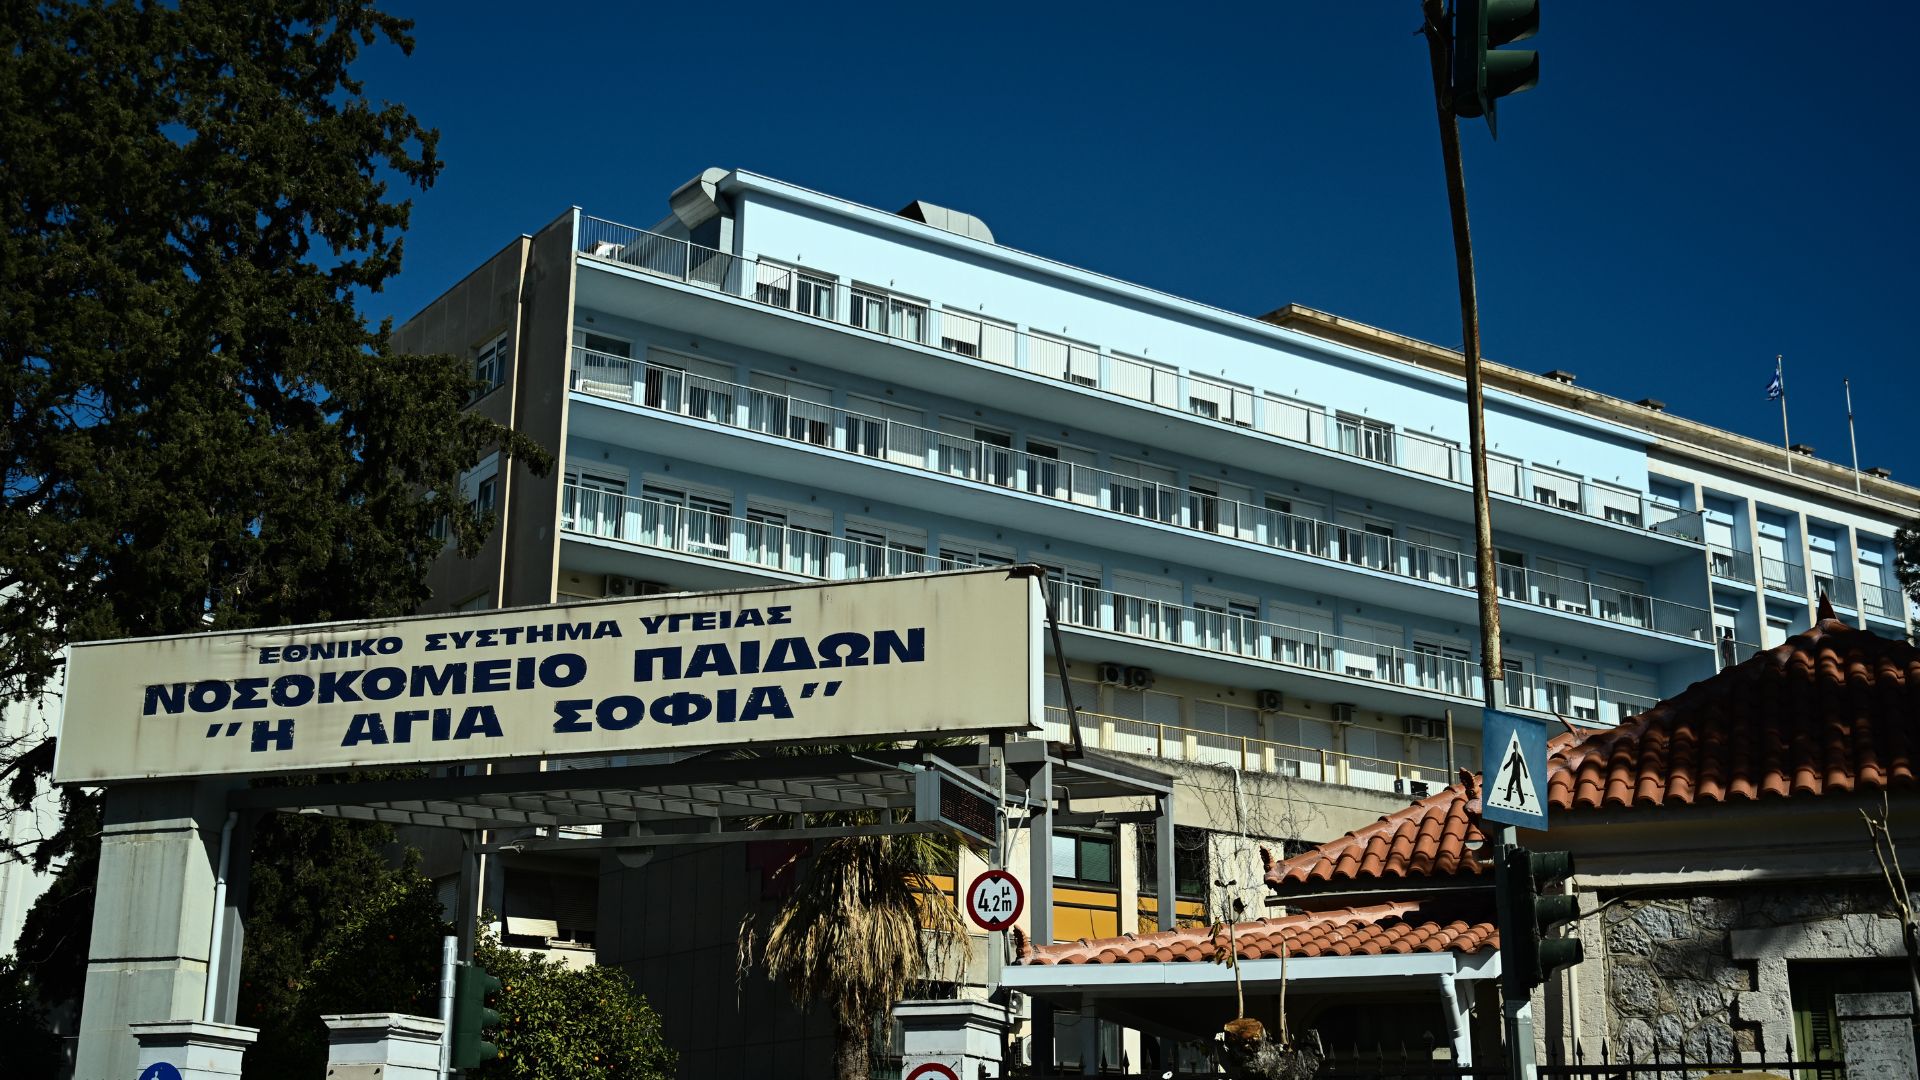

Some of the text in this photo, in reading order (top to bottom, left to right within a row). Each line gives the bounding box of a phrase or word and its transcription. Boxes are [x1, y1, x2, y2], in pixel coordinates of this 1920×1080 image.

[259, 606, 792, 665] ΕΘΝΙΚΟ ΣΥΣΤΗΜΑ ΥΓΕΙΑΣ
[143, 628, 925, 716] ΝΟΣΟΚΟΜΕΙΟ ΠΑΙΔΩΝ
[341, 705, 504, 747] ΑΓΙΑ
